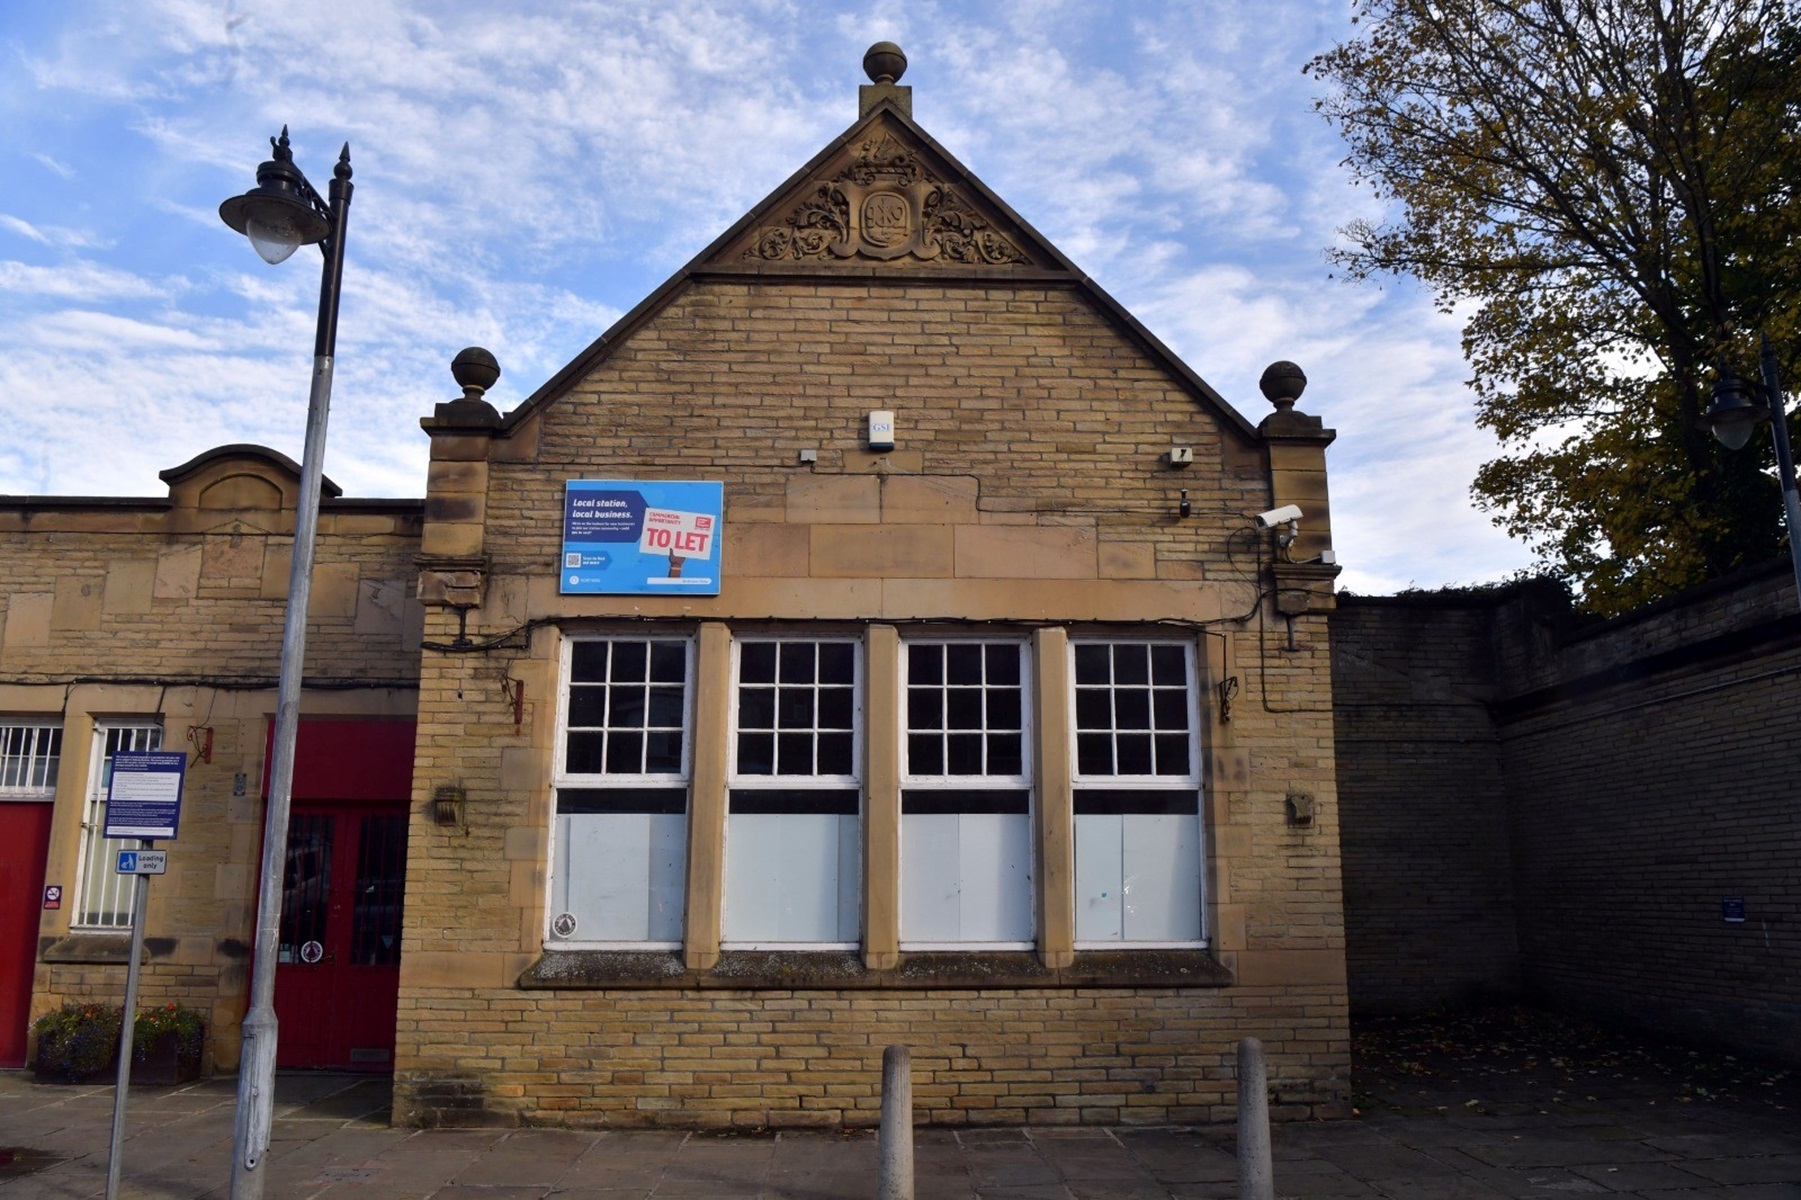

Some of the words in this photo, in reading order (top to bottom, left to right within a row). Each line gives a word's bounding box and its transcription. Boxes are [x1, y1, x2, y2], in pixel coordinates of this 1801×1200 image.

[573, 499, 595, 507] Local
[596, 499, 628, 508] station,
[572, 510, 593, 518] local
[594, 511, 633, 519] business.
[647, 527, 671, 548] TO
[674, 530, 709, 552] LET
[138, 853, 164, 863] Loading
[143, 862, 158, 870] only
